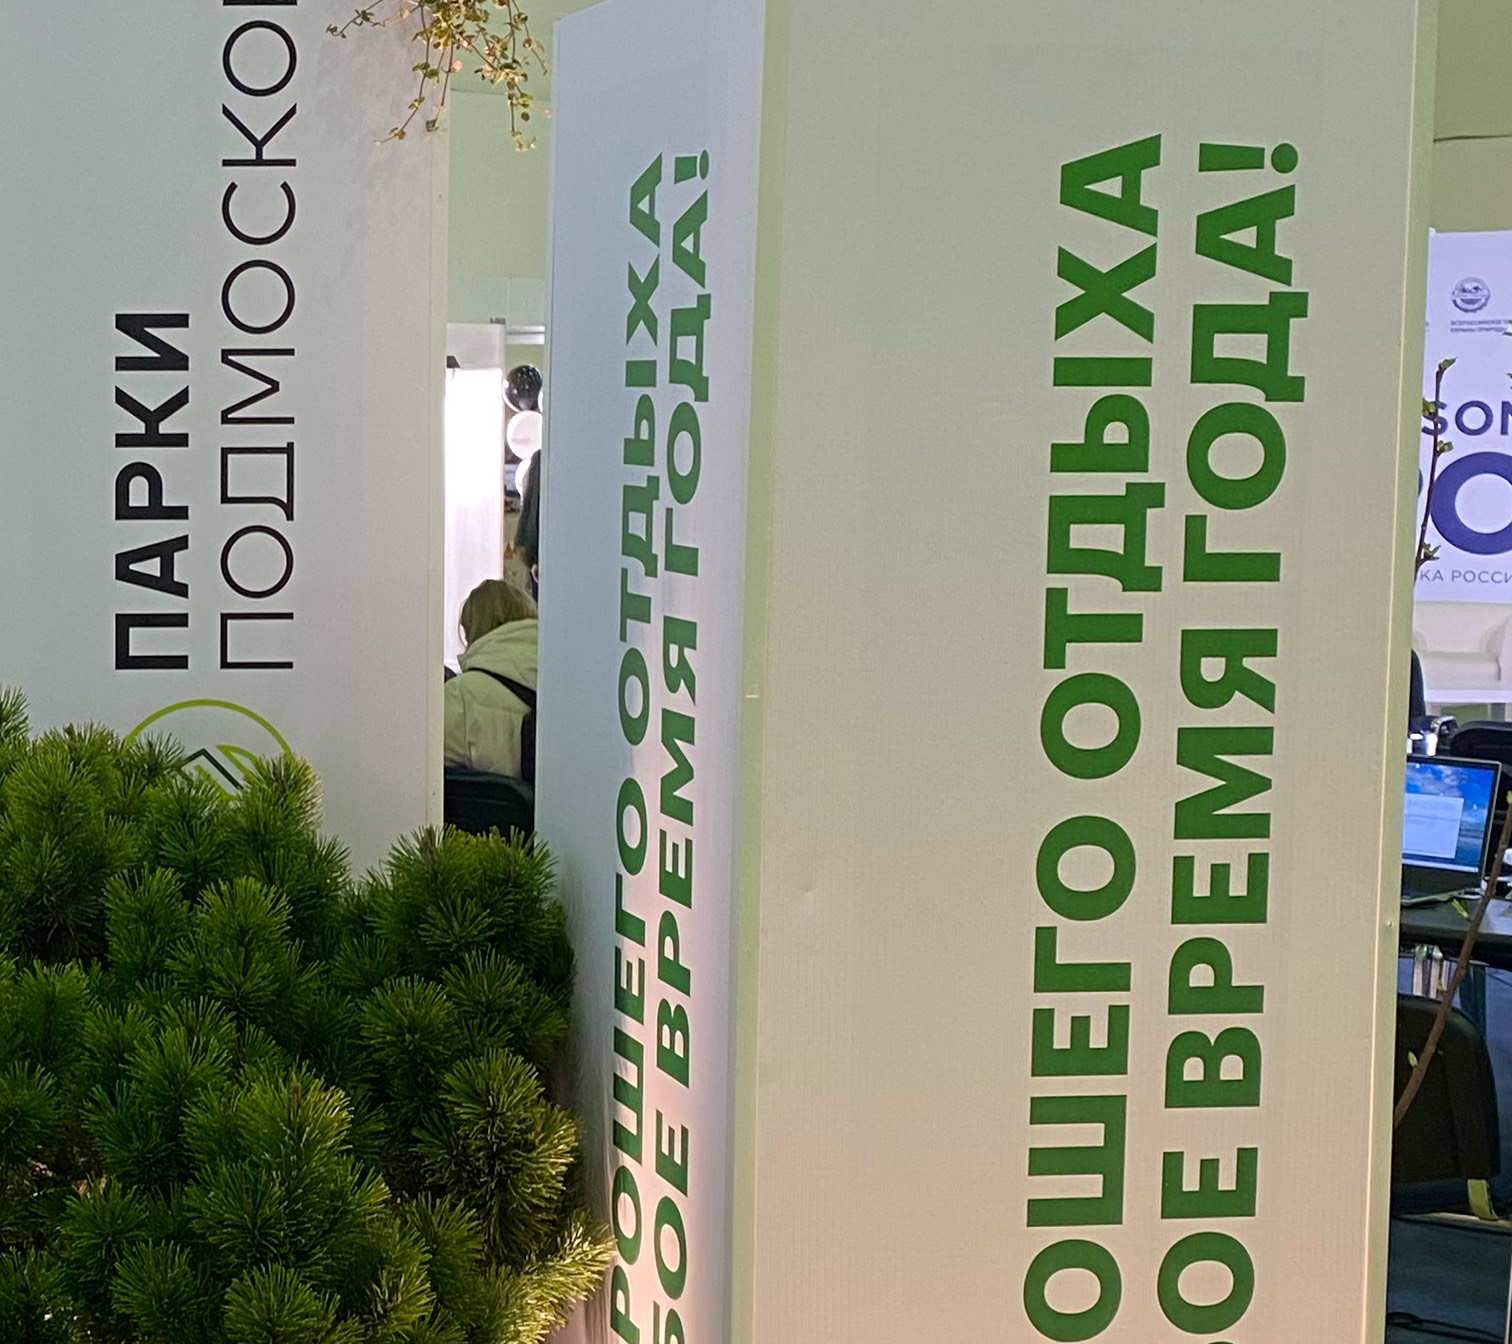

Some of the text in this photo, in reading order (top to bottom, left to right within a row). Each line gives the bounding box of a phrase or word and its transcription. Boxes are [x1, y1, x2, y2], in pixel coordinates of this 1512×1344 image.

[113, 312, 191, 672] ПАРКИ
[618, 151, 663, 746] ОТДЫХА
[663, 149, 711, 578] ГОДА!
[1039, 133, 1166, 781] ОТДЫХА
[1181, 142, 1309, 583] ГОДА!
[656, 615, 697, 1089] ВРЕМЯ
[1165, 627, 1279, 1108] ВРЕМЯ
